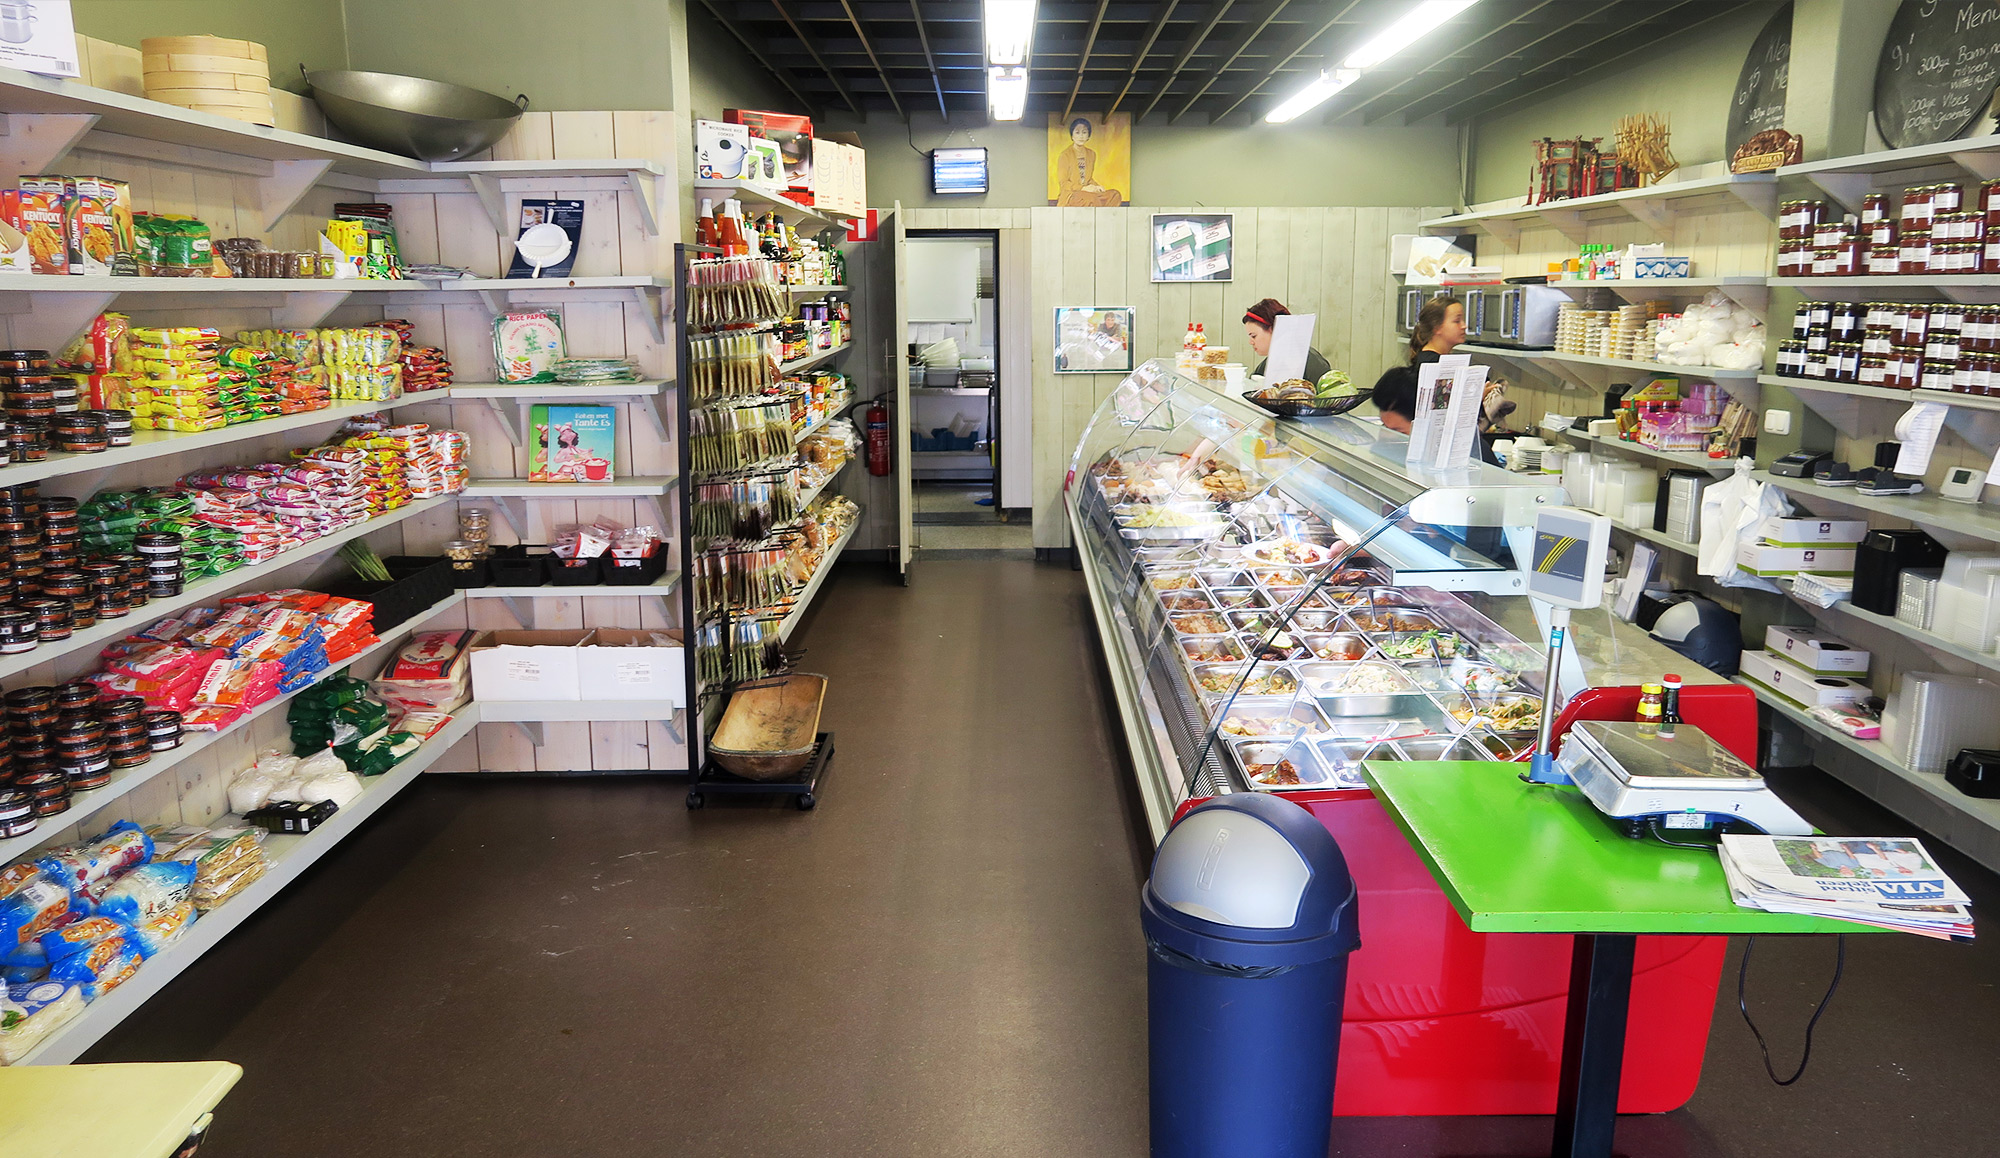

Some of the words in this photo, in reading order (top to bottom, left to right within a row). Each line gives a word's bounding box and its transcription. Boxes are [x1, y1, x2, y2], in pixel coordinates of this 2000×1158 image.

[23, 210, 61, 222] KENTUCKY
[526, 313, 548, 321] PAPER
[200, 664, 224, 691] Saimin
[1873, 881, 1945, 895] VIA
